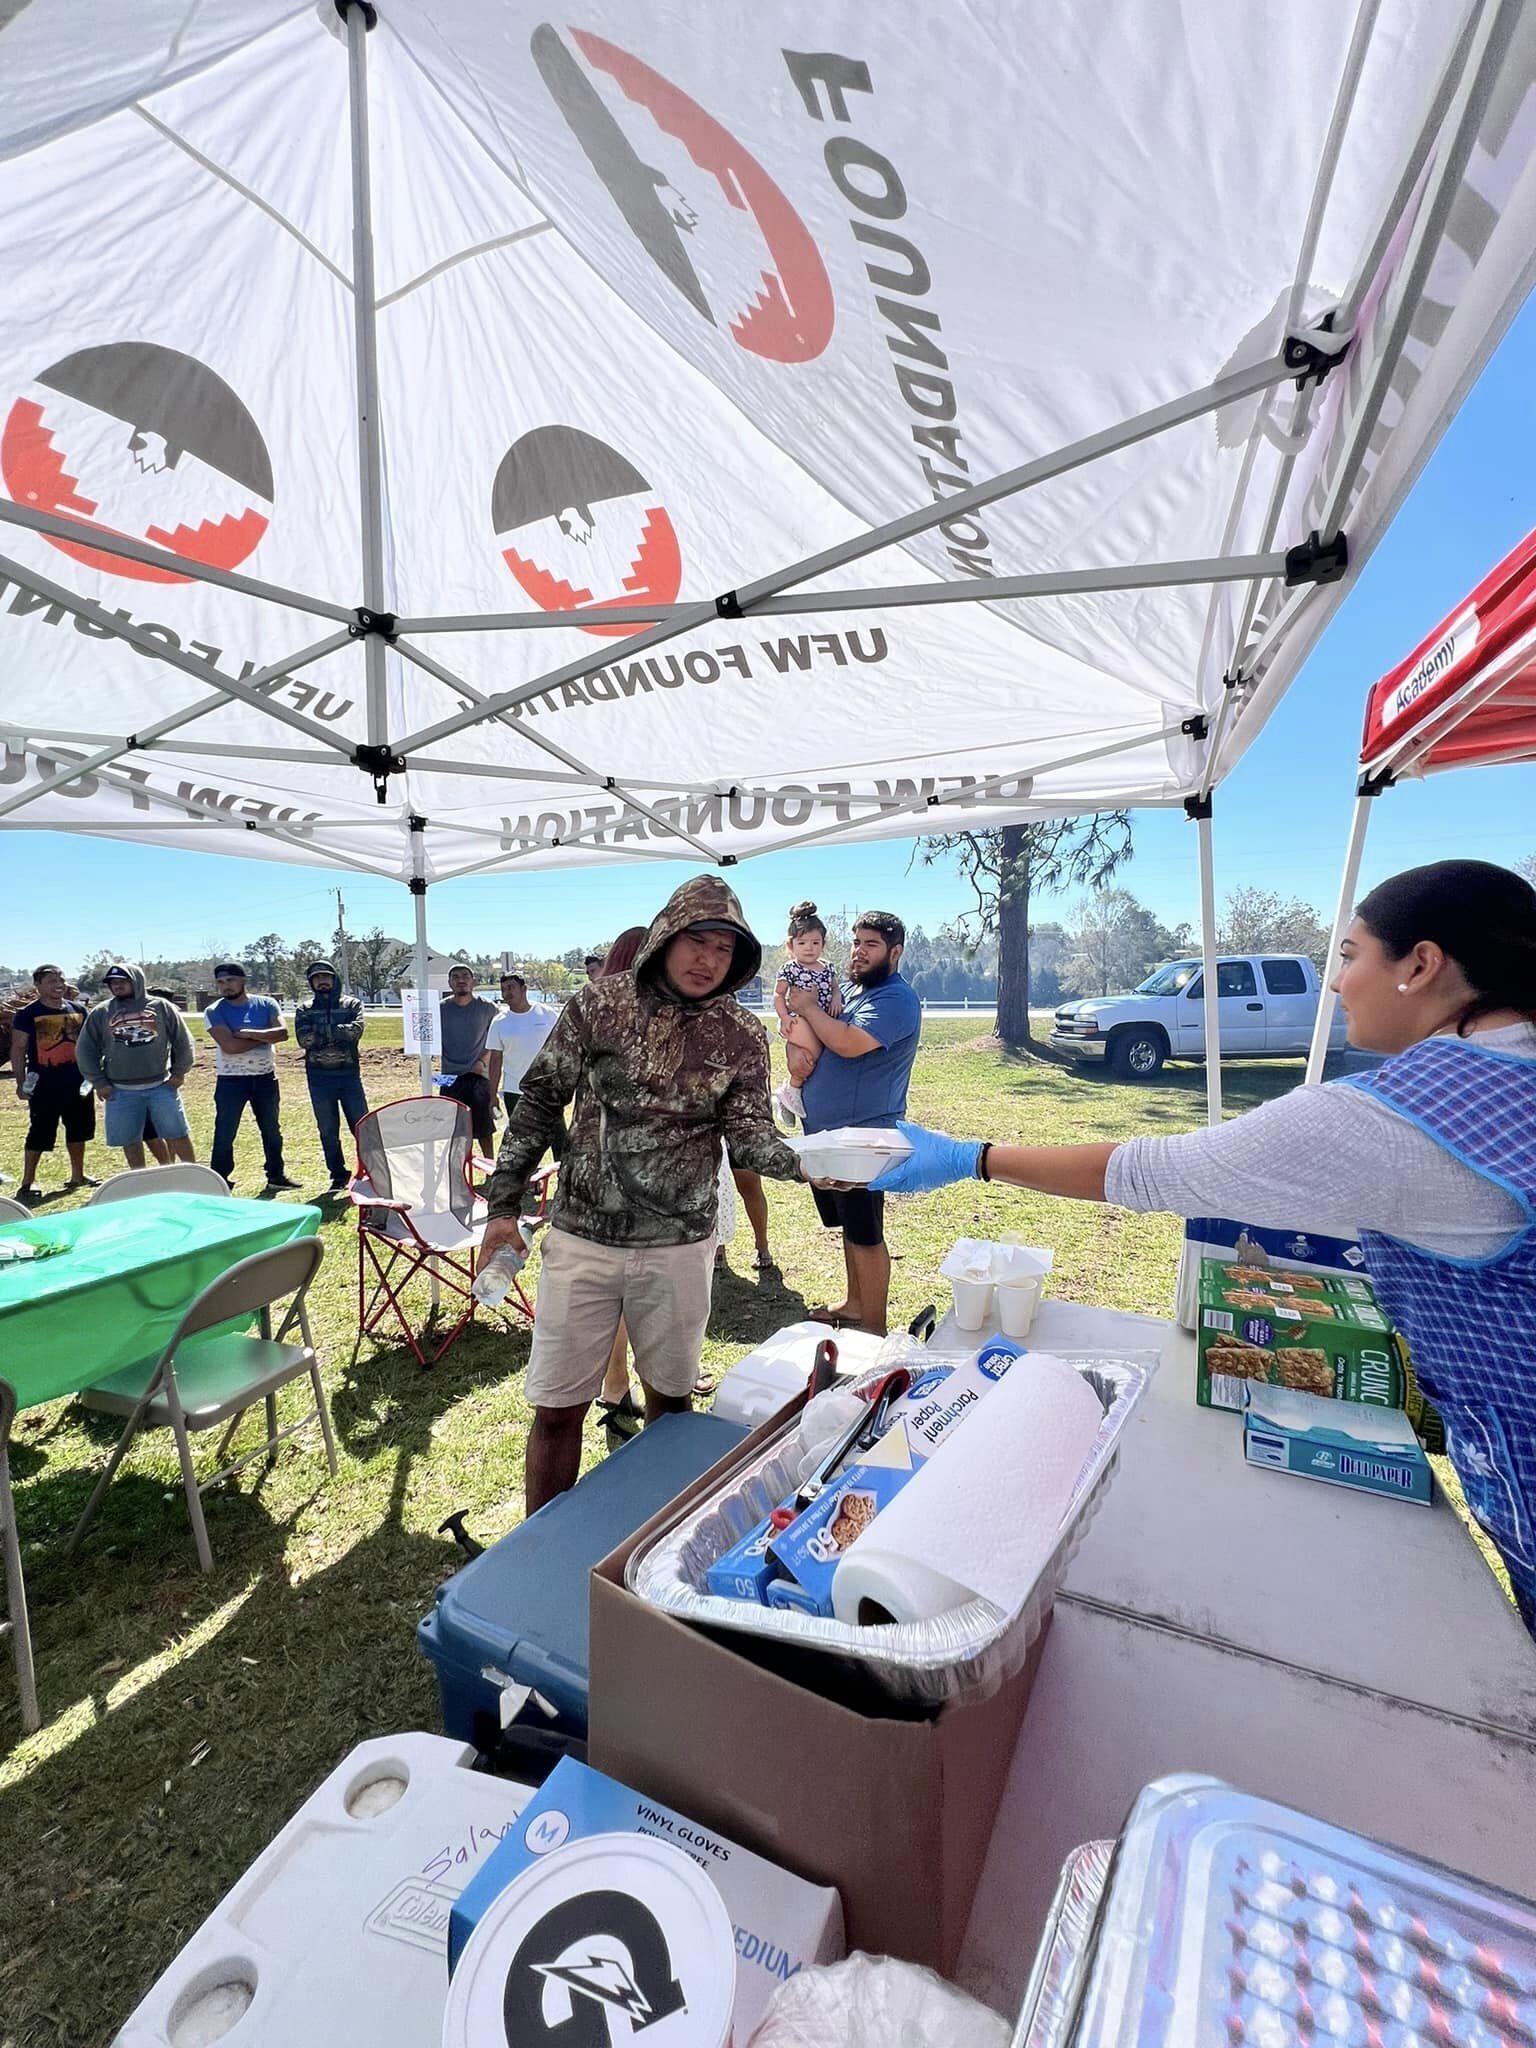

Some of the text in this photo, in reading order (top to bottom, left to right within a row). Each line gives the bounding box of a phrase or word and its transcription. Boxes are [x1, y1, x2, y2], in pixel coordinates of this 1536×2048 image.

[1396, 636, 1455, 713] Academy
[910, 1401, 943, 1430] Paper
[922, 1388, 980, 1444] Parchment
[806, 1527, 840, 1563] 50
[735, 1577, 756, 1598] 50
[536, 1820, 560, 1843] M
[637, 1804, 674, 1833] VINYL
[677, 1827, 732, 1862] GLOVES
[731, 1923, 803, 1982] EDIUM
